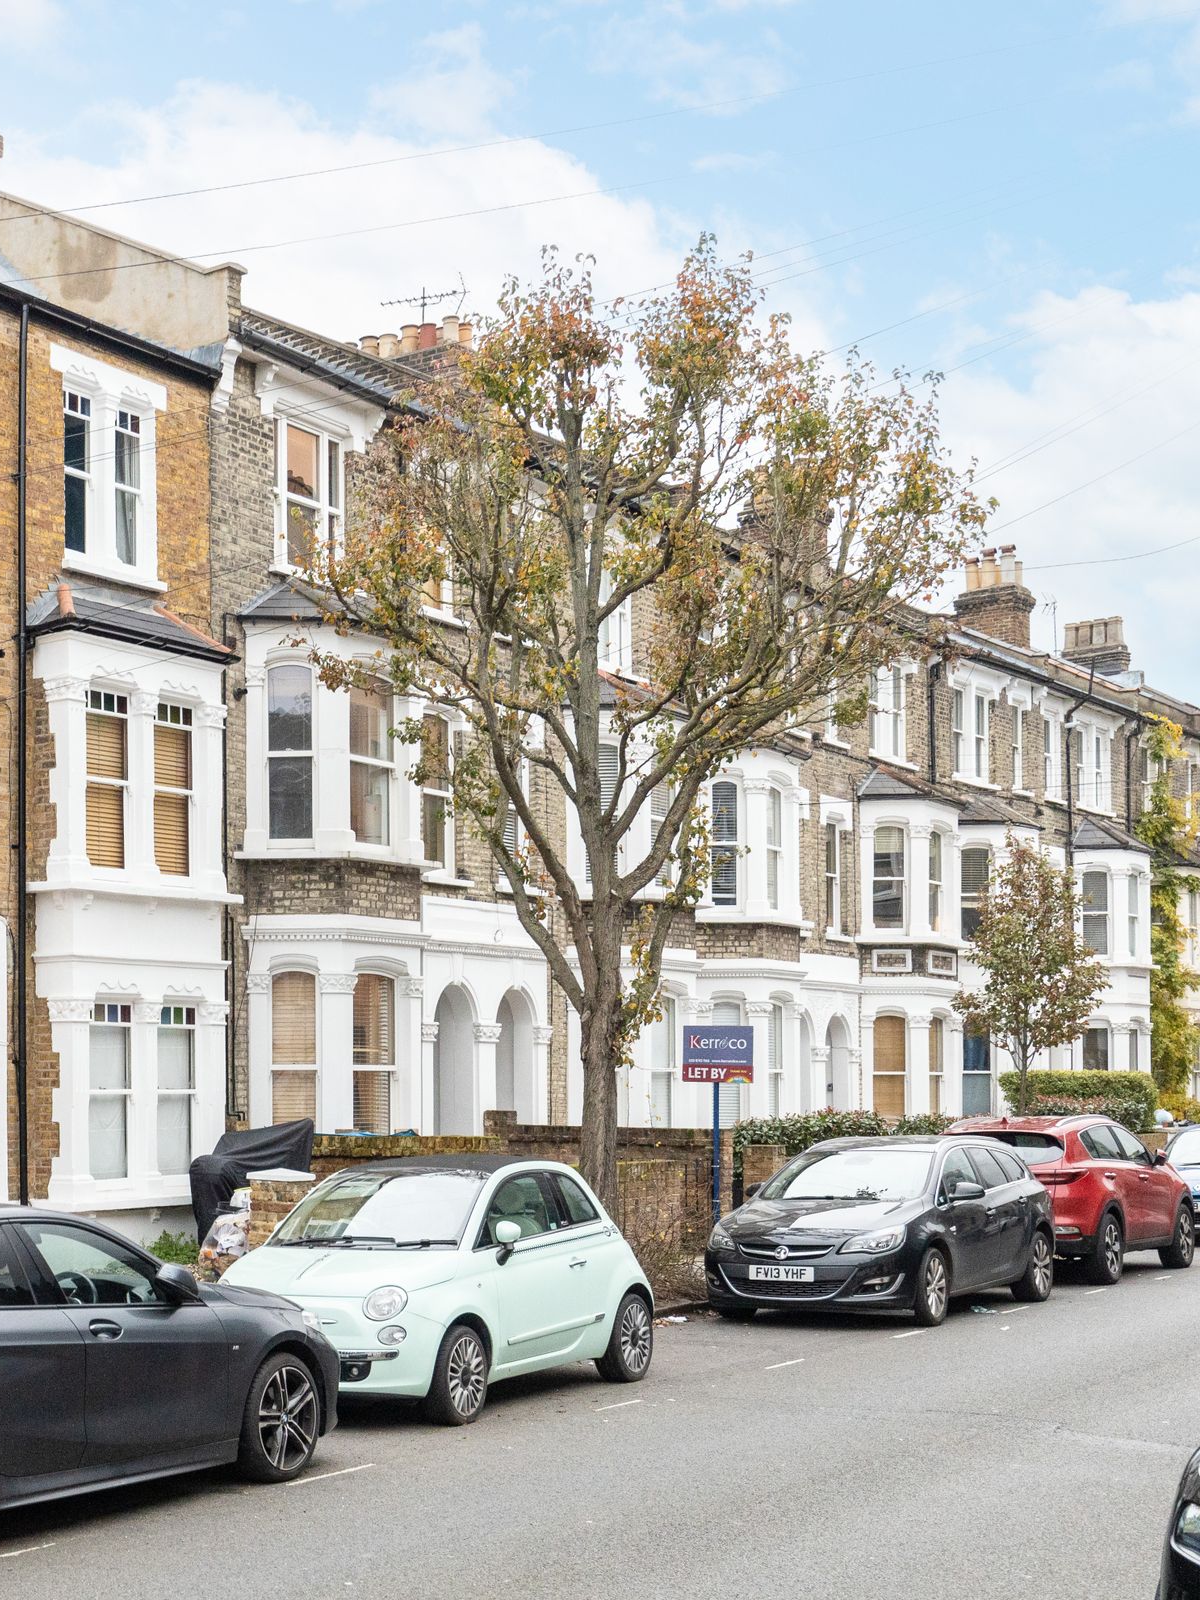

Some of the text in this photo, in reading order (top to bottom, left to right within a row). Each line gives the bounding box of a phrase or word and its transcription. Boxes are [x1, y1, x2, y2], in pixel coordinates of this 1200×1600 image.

[688, 1067, 708, 1079] LET
[710, 1068, 727, 1079] BY
[755, 1267, 807, 1279] FV13 YHF
